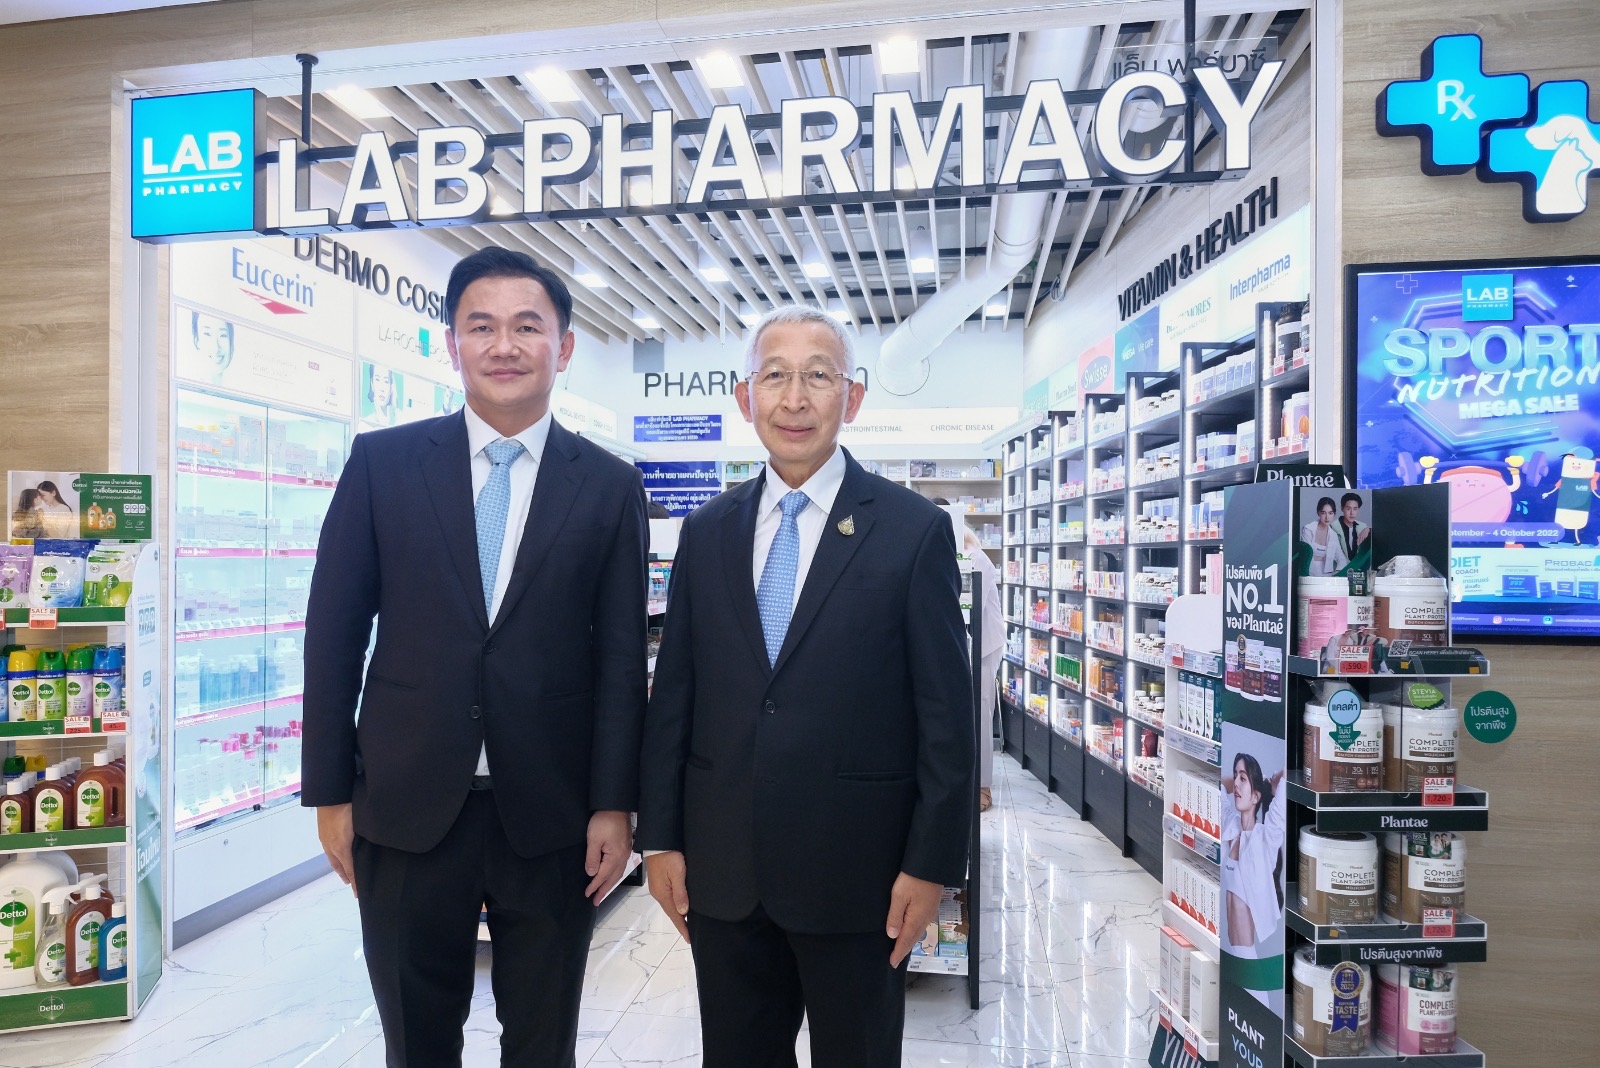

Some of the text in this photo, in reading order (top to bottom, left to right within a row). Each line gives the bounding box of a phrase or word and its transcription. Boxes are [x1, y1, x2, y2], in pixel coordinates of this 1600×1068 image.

[279, 59, 1286, 229] LAB PHARMACY
[143, 131, 242, 175] LAB
[143, 181, 242, 196] PHARMACY
[1118, 177, 1278, 321] VITAMIN & HEALTH
[294, 234, 390, 296] DERMO
[232, 246, 314, 308] Eucerin
[1230, 254, 1291, 301] Interpharma
[1467, 287, 1509, 301] LAB
[1383, 324, 1600, 377] SPORT
[1084, 363, 1109, 389] Swisse
[1397, 362, 1600, 403] NUTRITION
[1459, 394, 1579, 420] MEGA SALE
[930, 424, 963, 432] CHRONIC
[643, 467, 720, 482] ถานที่ขายยาแผนปัจจุบัน
[1267, 469, 1334, 487] Plantaé
[1493, 529, 1498, 537] 4
[1500, 529, 1535, 537] October
[1537, 528, 1559, 537] 2022
[1226, 563, 1263, 580] โปรตีนพืช
[1226, 613, 1284, 635] ของ Plantaé
[1341, 646, 1361, 654] SALE
[1470, 705, 1509, 718] โปรตีนสูง
[1475, 719, 1507, 730] จากพืช
[1409, 738, 1455, 747] COMPLETE
[1425, 778, 1445, 786] SALE
[1331, 870, 1376, 879] COMPLETE
[1424, 868, 1465, 877] COMPLETE
[0, 909, 27, 920] Dettol
[80, 926, 100, 936] Dettol
[112, 935, 127, 944] Detto
[1360, 946, 1443, 962] โปรตีนสูงจากพืช
[39, 1003, 64, 1012] Dettol
[1335, 1006, 1358, 1015] TASTE
[1420, 999, 1455, 1010] COMPLETE
[1228, 1007, 1265, 1050] PLANT
[1231, 1034, 1264, 1068] YOUR
